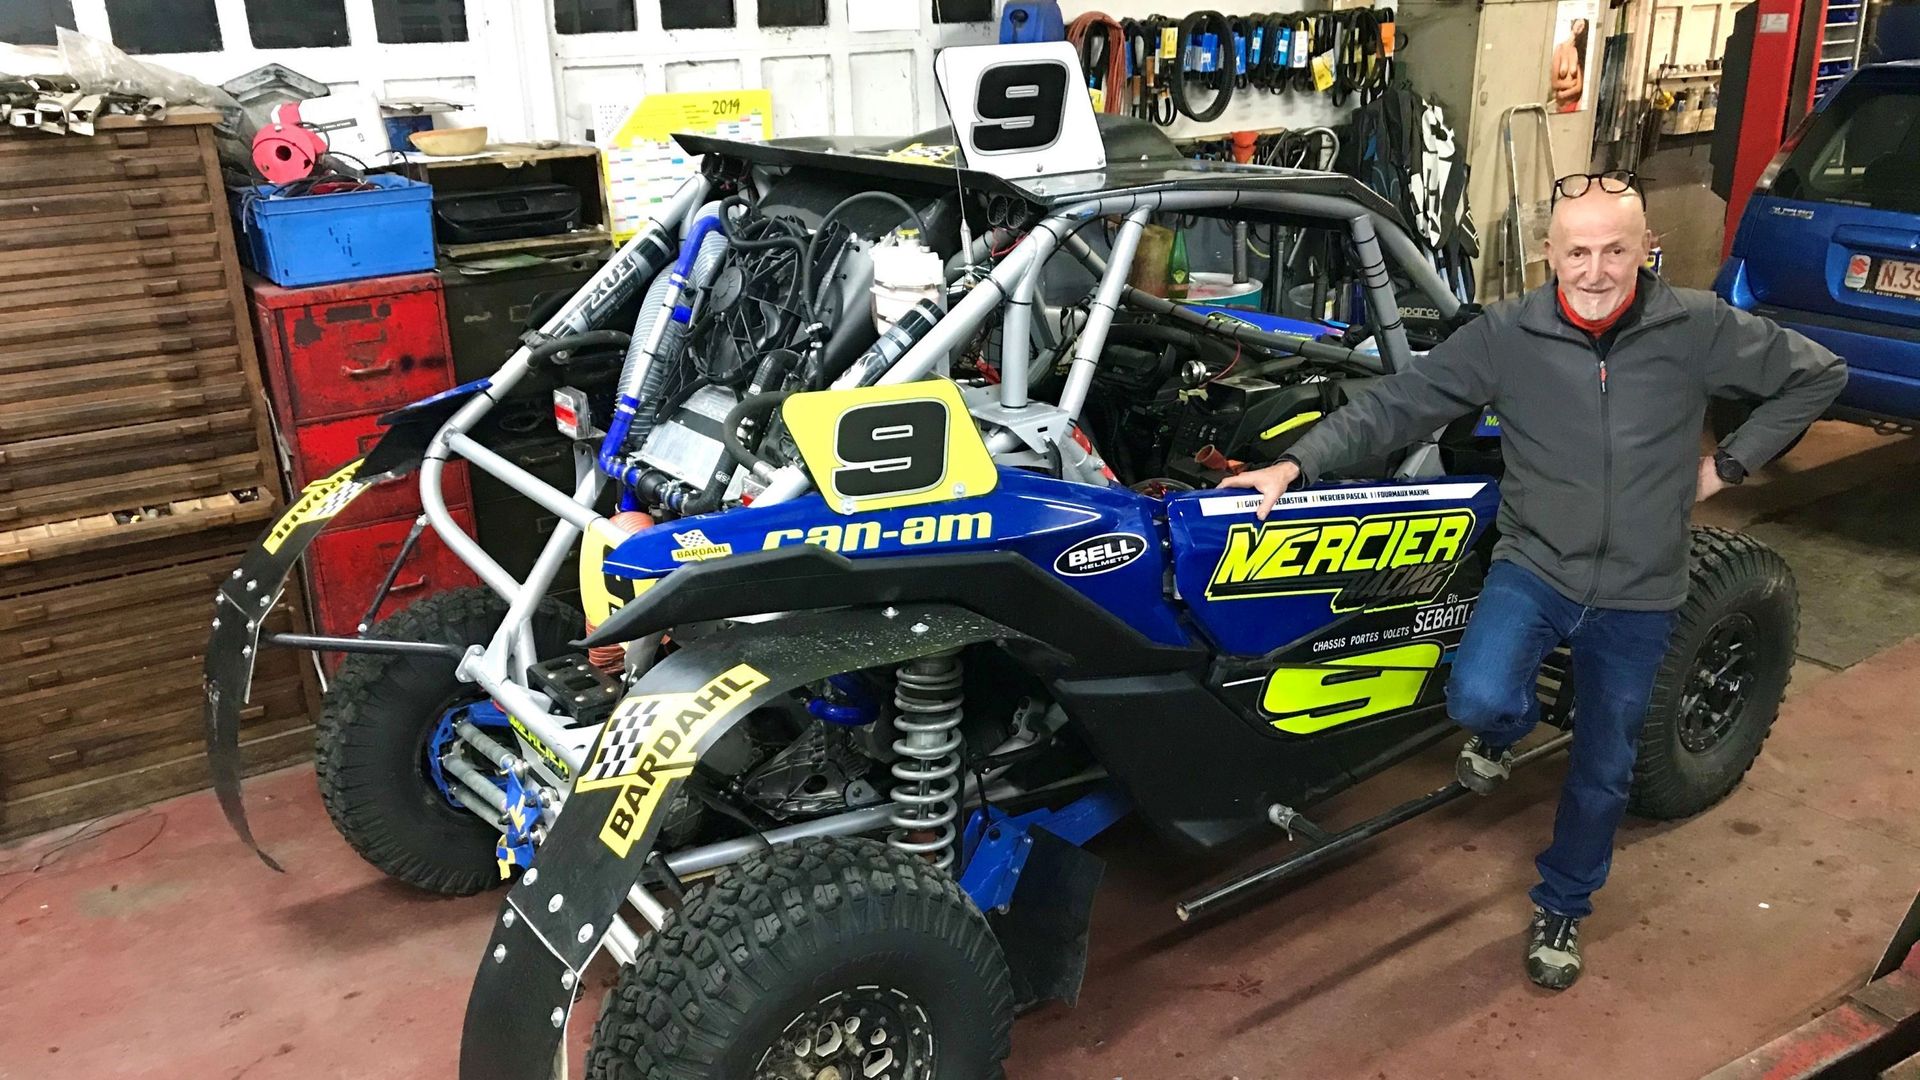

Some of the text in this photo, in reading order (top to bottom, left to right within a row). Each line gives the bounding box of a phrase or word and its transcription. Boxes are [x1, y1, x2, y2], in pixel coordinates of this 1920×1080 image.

[713, 98, 741, 115] 2019
[969, 59, 1070, 156] 9
[831, 397, 950, 500] 9
[268, 464, 361, 544] ARDAHL
[1274, 495, 1308, 506] SEBASTIEN
[1319, 492, 1346, 502] MERCIER
[1346, 491, 1369, 501] PASCAL
[1377, 489, 1409, 499] FOURMAUX
[1409, 488, 1430, 497] MAXIME
[762, 511, 993, 553] can-am
[1213, 514, 1471, 585] MERCIER
[676, 545, 729, 559] BARDAHL
[1068, 539, 1137, 568] BELL
[1079, 554, 1130, 572] HELMETS
[1312, 625, 1410, 653] CHASSIS PORTES VOLETS
[608, 676, 755, 840] BARDAHL
